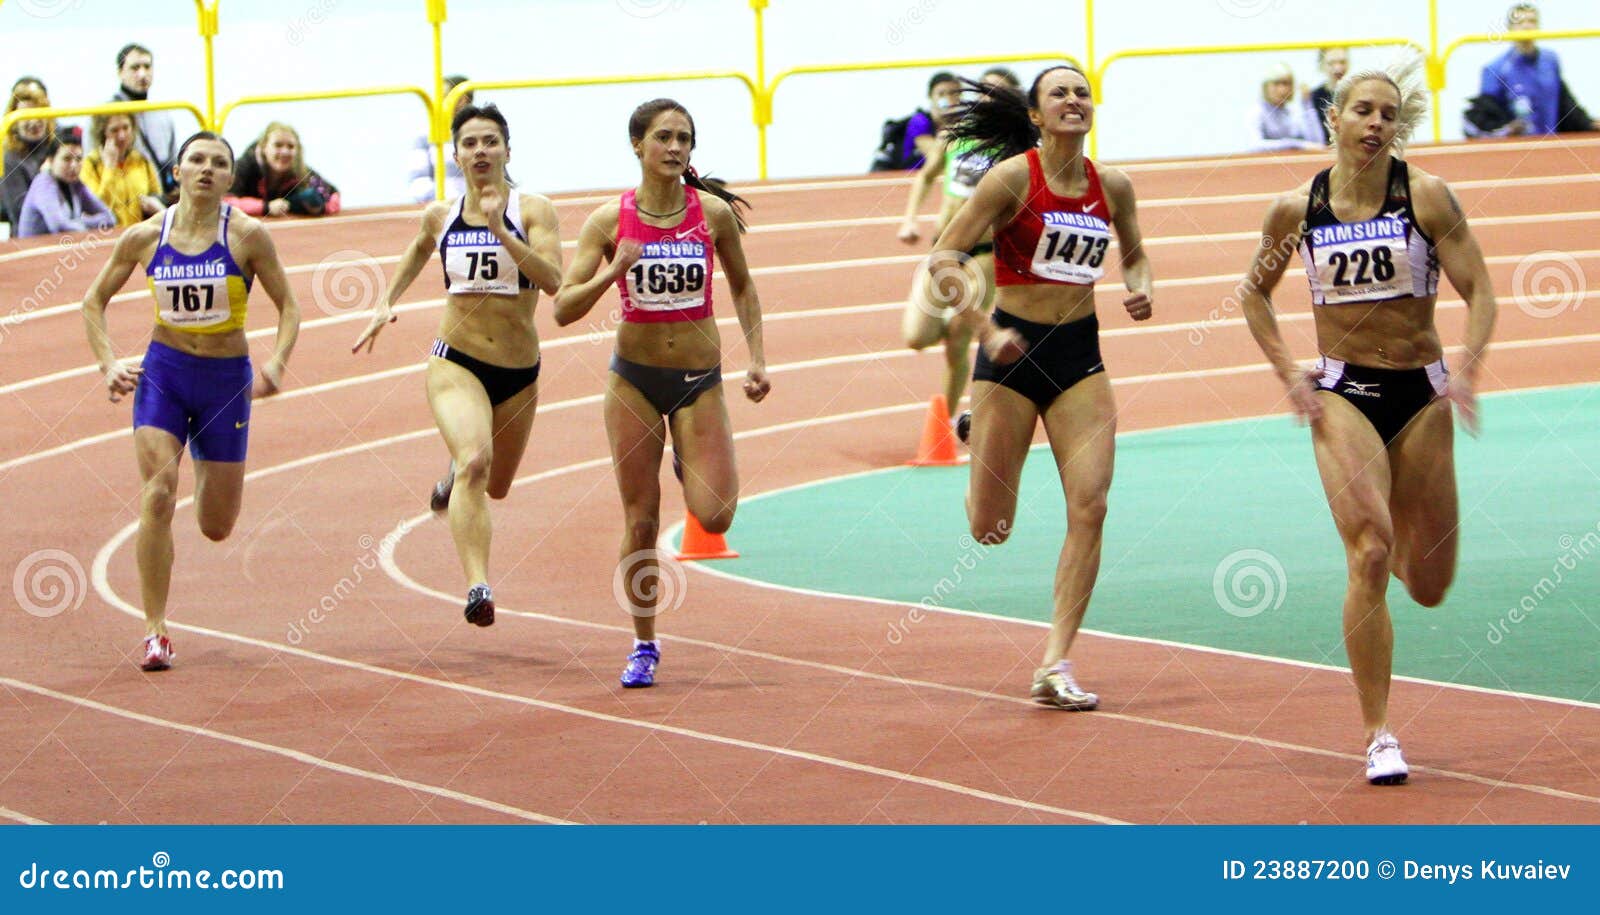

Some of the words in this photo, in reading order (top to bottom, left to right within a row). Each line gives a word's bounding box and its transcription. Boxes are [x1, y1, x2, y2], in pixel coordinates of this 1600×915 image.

[447, 231, 501, 245] SAMSU
[1313, 219, 1404, 246] SAMSUNG
[640, 243, 704, 257] MSUNG
[1044, 230, 1109, 269] 1473
[154, 262, 226, 280] SAMSUNG
[466, 251, 499, 281] 75
[630, 263, 704, 295] 1639
[1328, 245, 1396, 287] 228
[166, 283, 214, 312] 767
